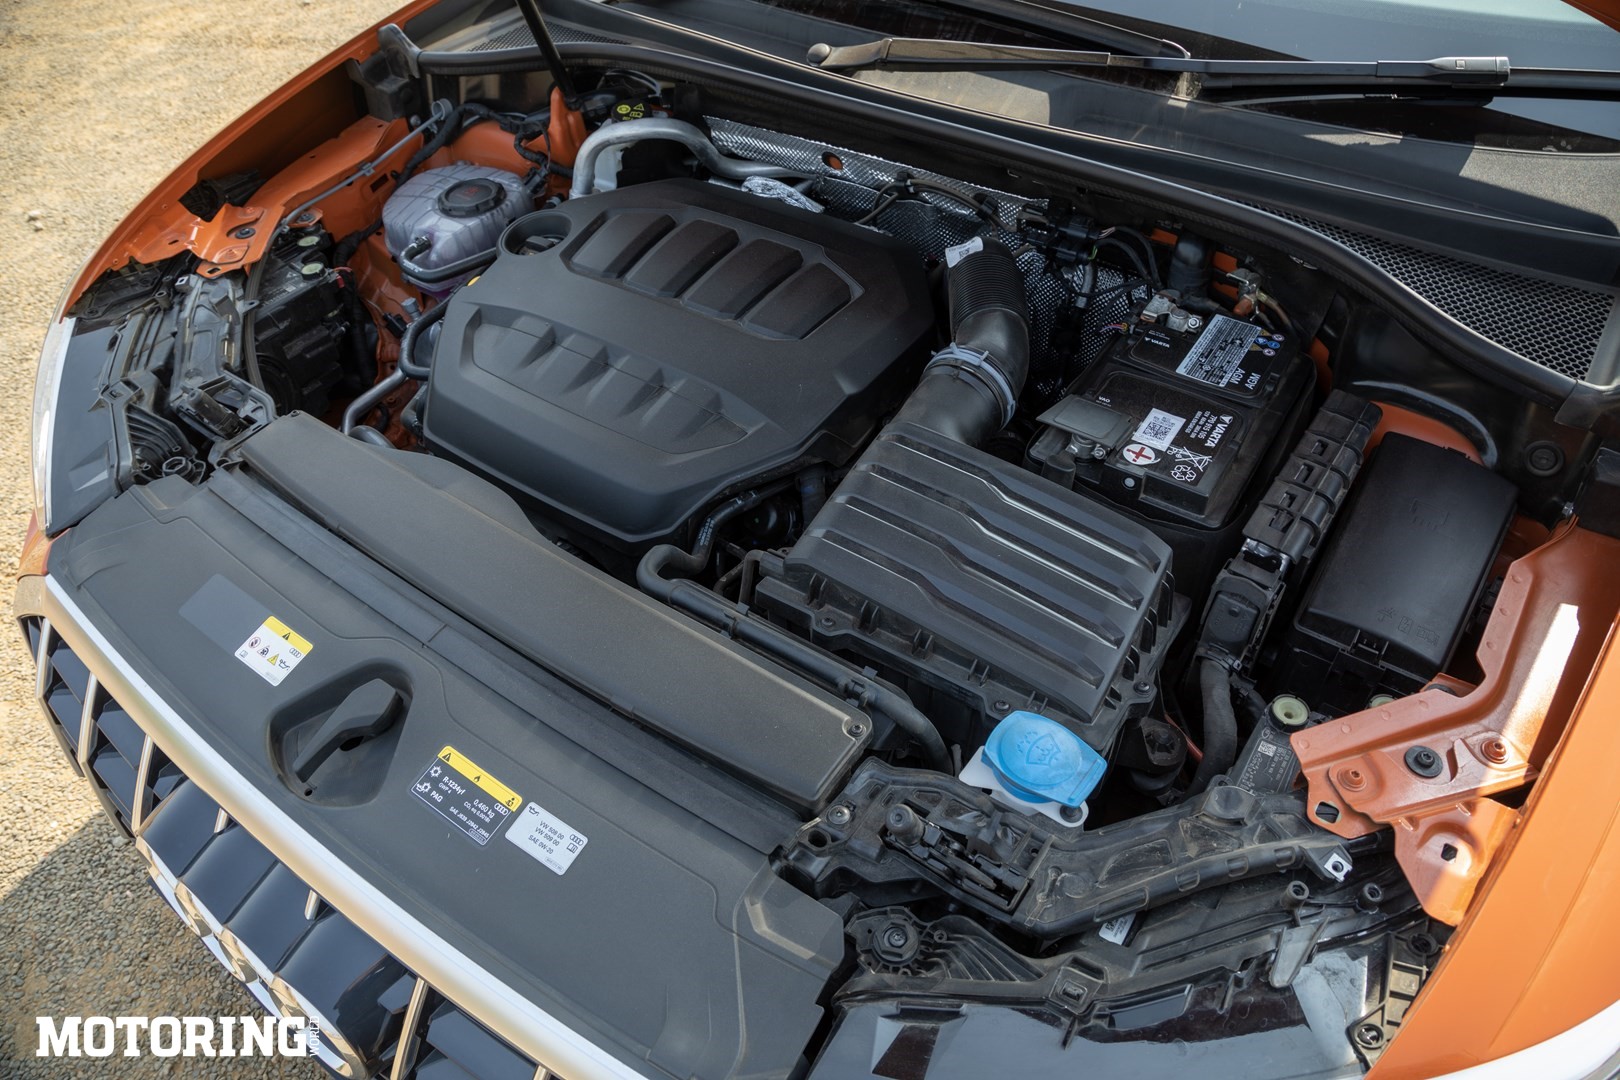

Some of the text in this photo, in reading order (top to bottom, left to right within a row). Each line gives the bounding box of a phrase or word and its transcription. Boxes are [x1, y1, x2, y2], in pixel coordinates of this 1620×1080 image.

[1151, 338, 1170, 348] VARTA
[1229, 367, 1245, 385] AGM
[1245, 372, 1261, 390] AGM
[1204, 424, 1228, 447] VARTA
[430, 790, 443, 803] PAG
[442, 776, 466, 796] R-1234yf
[487, 809, 496, 819] kg
[535, 827, 545, 836] VW
[540, 820, 549, 830] VW
[528, 835, 554, 854] SAE 0W-20
